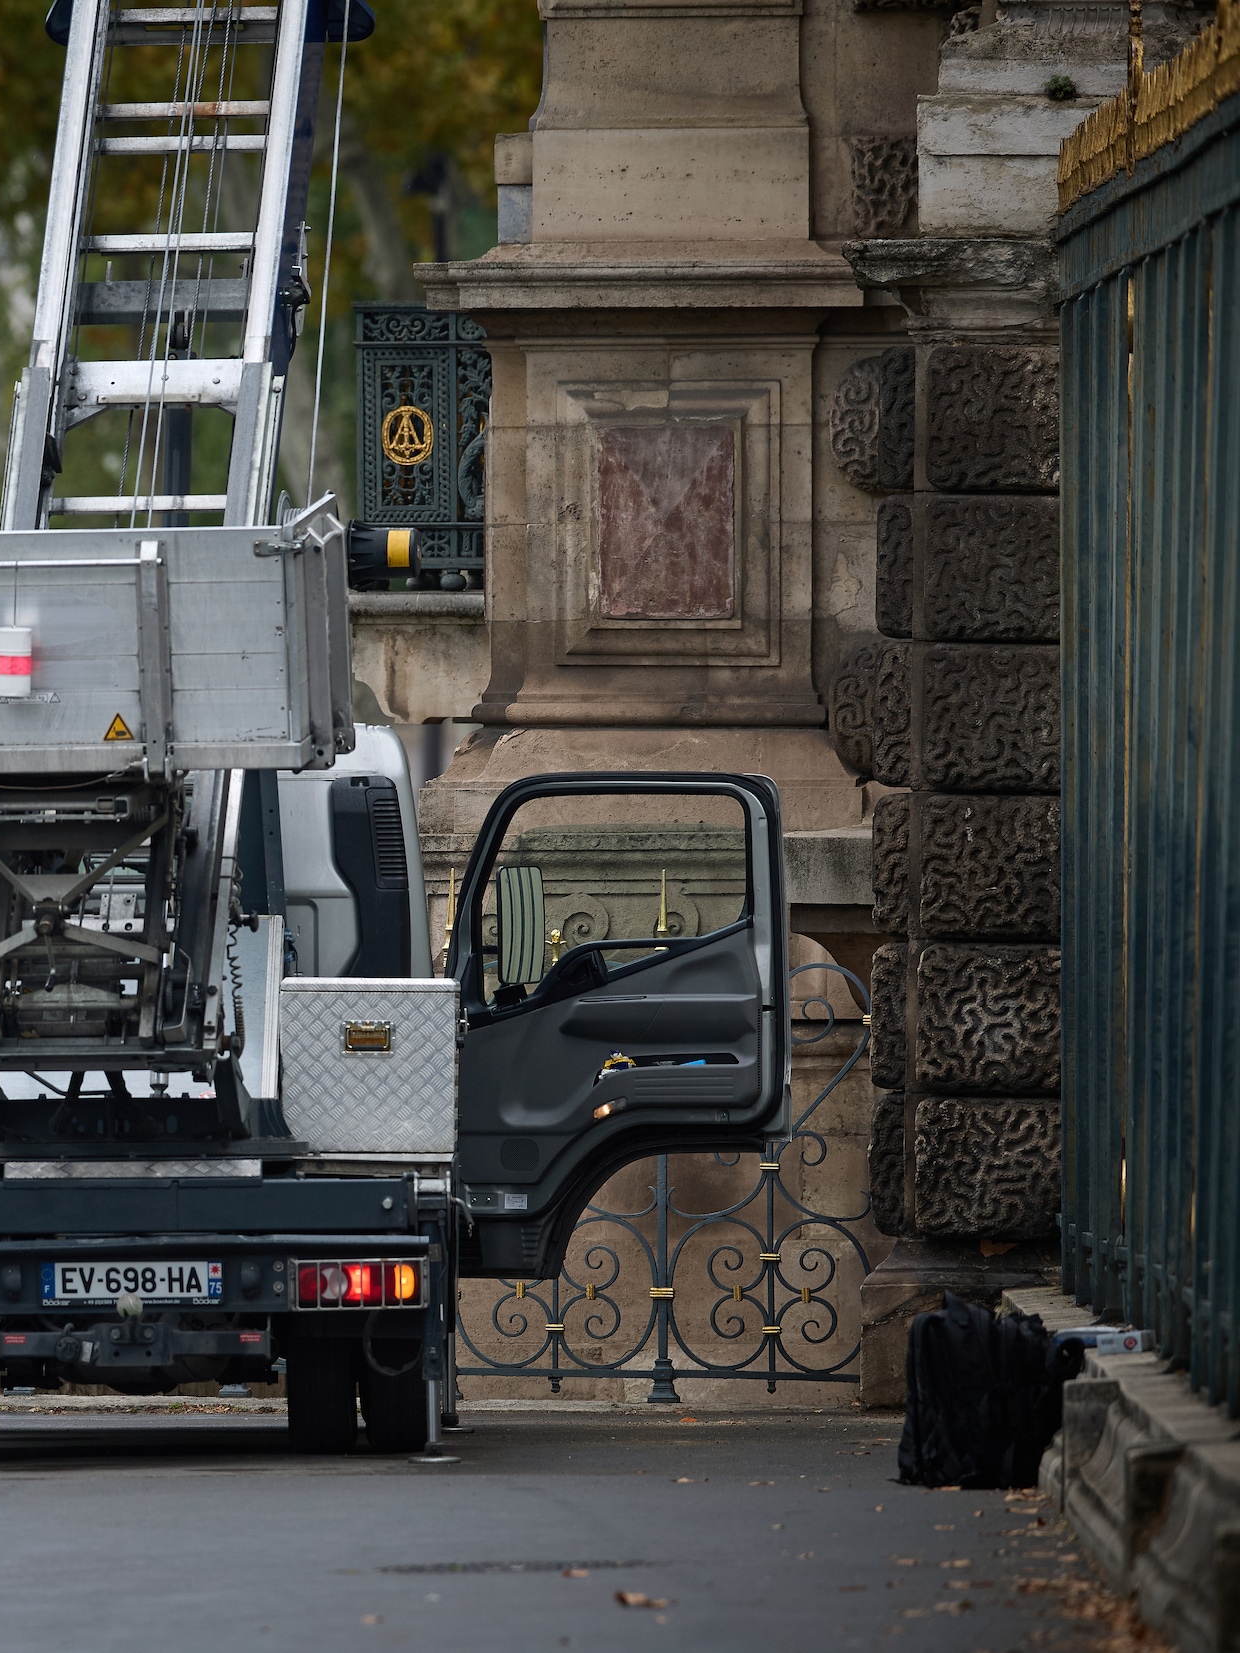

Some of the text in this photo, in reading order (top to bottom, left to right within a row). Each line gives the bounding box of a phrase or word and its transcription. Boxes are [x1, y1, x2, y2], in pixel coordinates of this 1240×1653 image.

[44, 1266, 222, 1295] F EV-698-HA 75
